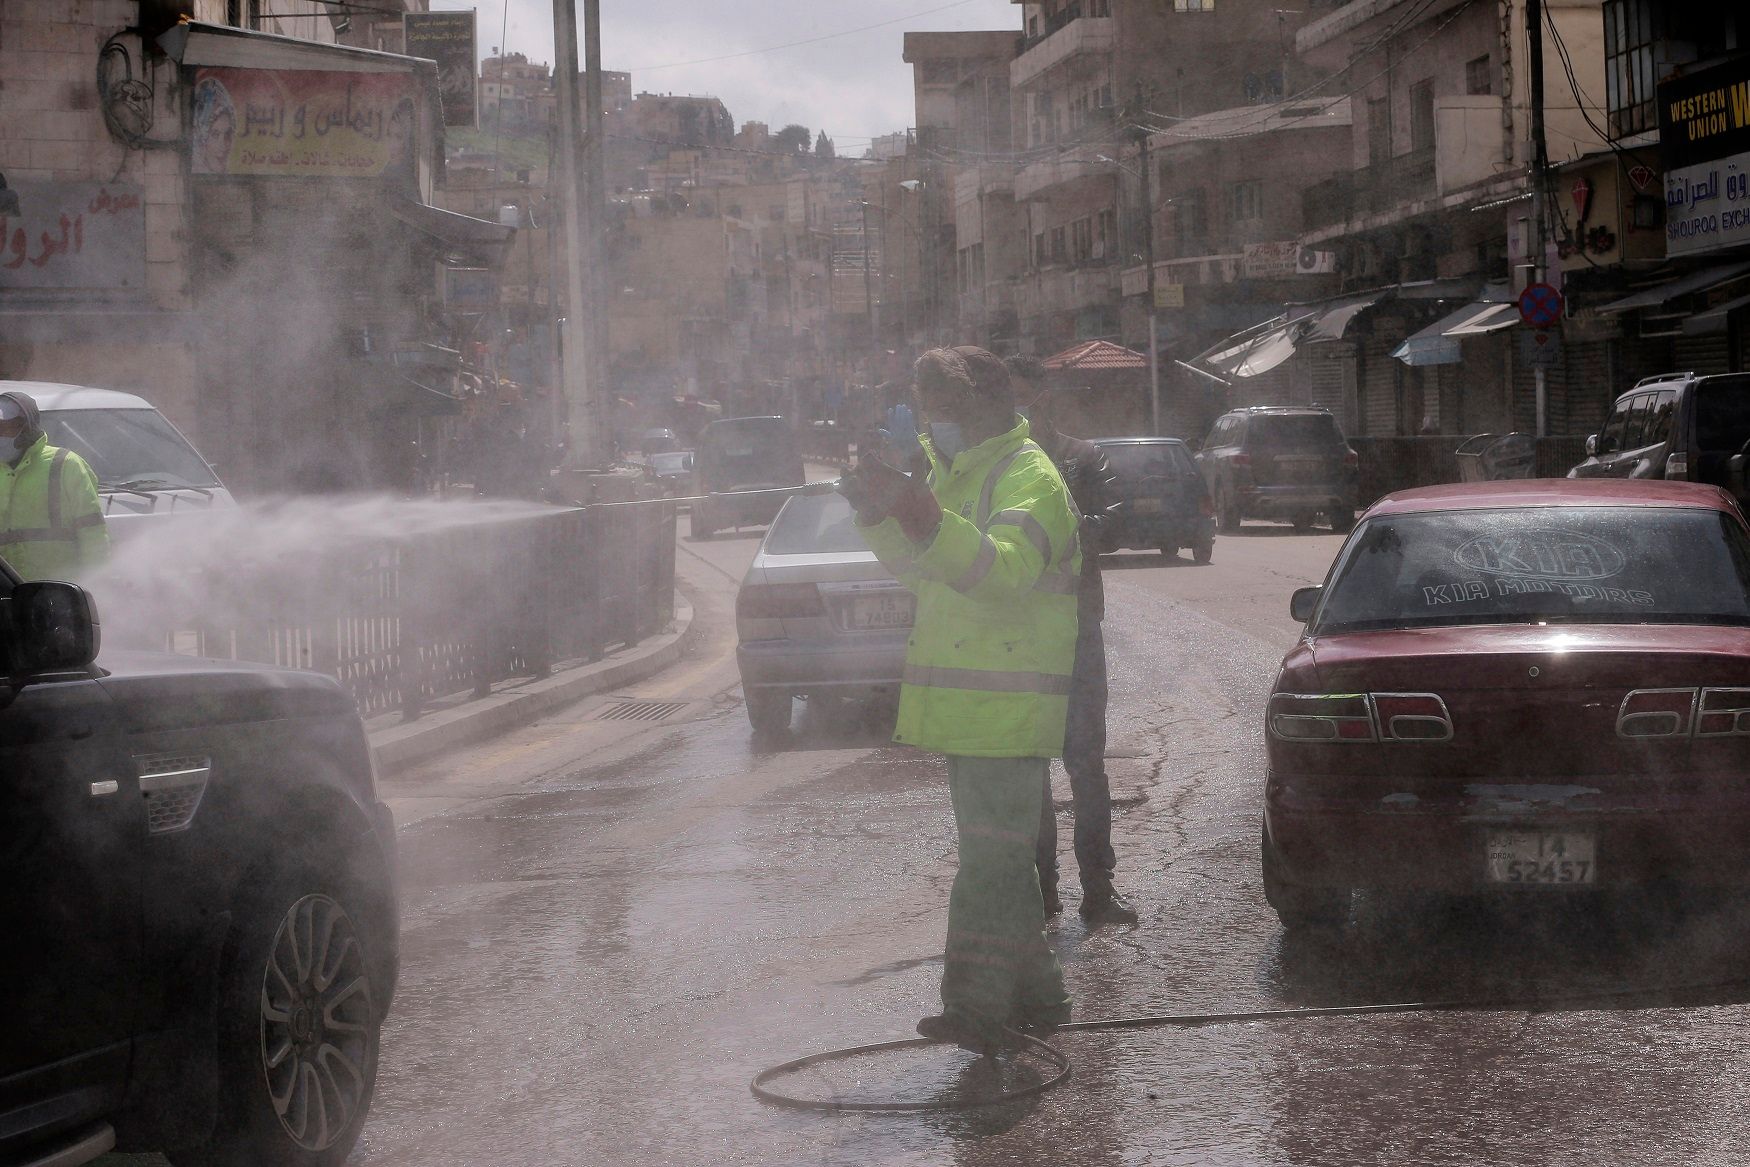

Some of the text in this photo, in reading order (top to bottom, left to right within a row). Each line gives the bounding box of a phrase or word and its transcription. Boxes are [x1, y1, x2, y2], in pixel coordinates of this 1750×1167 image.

[315, 81, 382, 141] ريماس
[1671, 88, 1725, 122] WESTERN
[293, 102, 307, 140] و
[1688, 112, 1727, 141] UNION
[88, 187, 139, 214] معرض
[1667, 170, 1718, 210] للصرافة
[1667, 214, 1718, 239] SHOUROQ
[1474, 534, 1606, 577] KIA
[1423, 578, 1655, 607] KIA MOTORS
[1490, 852, 1514, 860] JORDAN
[1507, 861, 1590, 882] 52457
